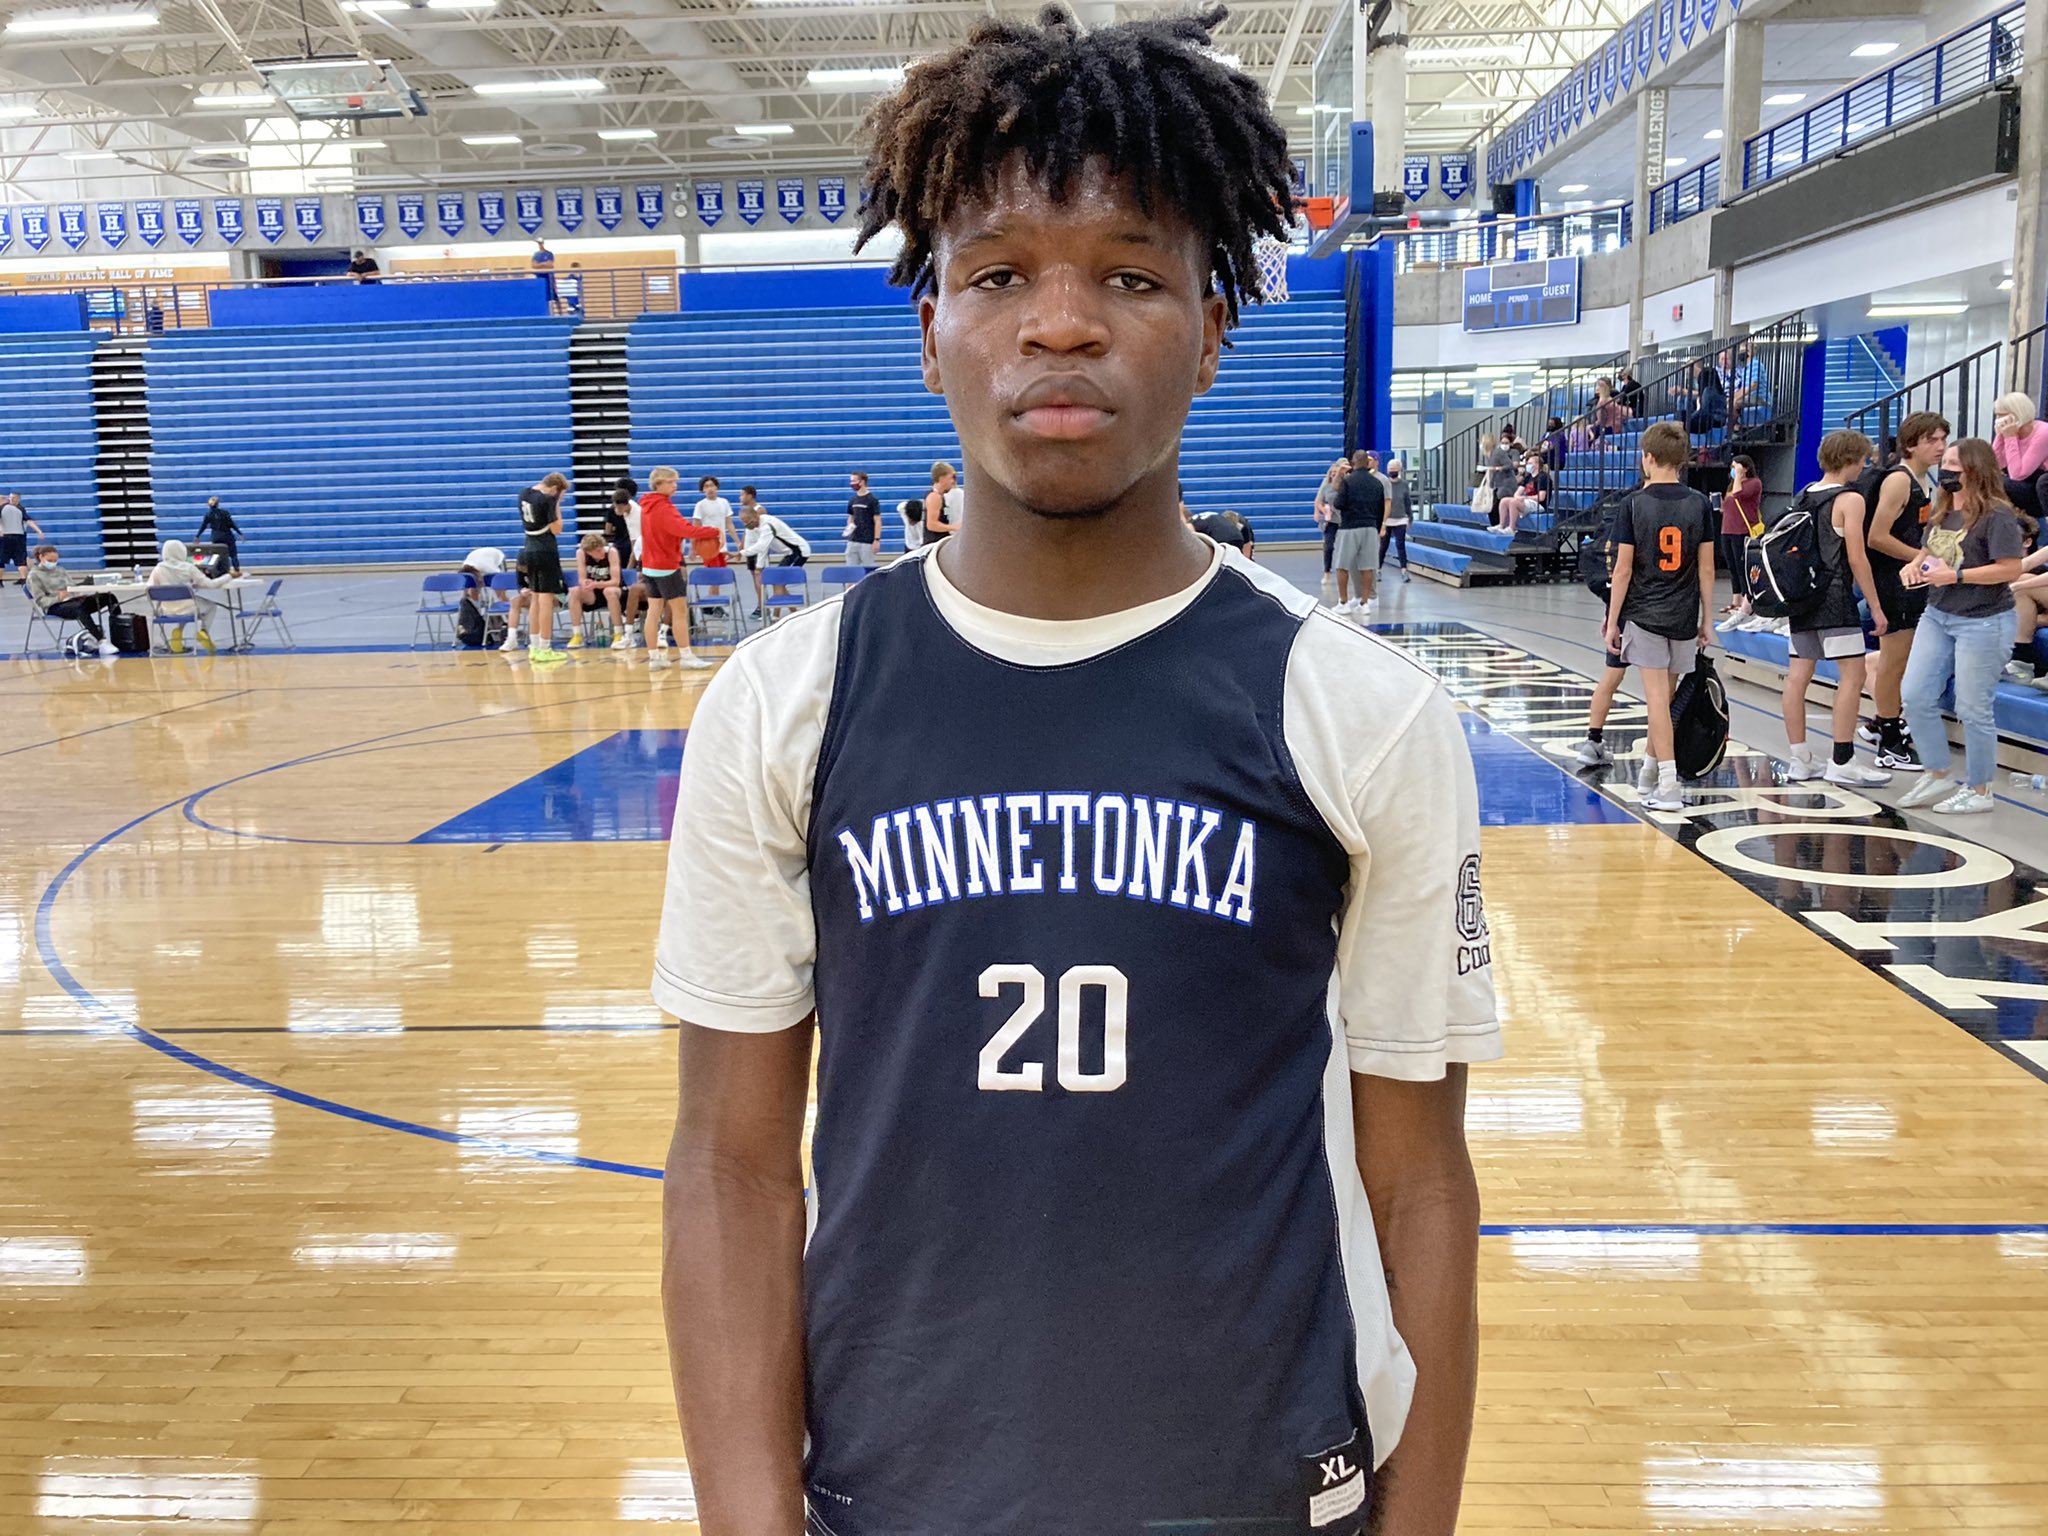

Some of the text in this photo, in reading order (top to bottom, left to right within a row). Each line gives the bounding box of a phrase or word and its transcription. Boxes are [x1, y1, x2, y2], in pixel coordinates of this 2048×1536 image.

[1646, 89, 1666, 186] CHALLENGE
[1408, 168, 1423, 184] H
[1447, 167, 1462, 182] H
[642, 197, 658, 212] H
[702, 194, 717, 210] H
[743, 193, 759, 208] H
[783, 191, 799, 207] H
[824, 190, 839, 205] H
[403, 206, 419, 221] H
[443, 205, 459, 220] H
[483, 203, 499, 219] H
[522, 202, 537, 217] H
[562, 200, 577, 215] H
[601, 198, 617, 214] H
[104, 215, 120, 230] H
[143, 214, 158, 229] H
[181, 212, 197, 228] H
[221, 211, 237, 227] H
[262, 210, 278, 225] H
[301, 209, 316, 225] H
[363, 208, 379, 223] H
[27, 218, 43, 233] H
[65, 216, 80, 231] H
[25, 269, 174, 282] HOPKINS ATHLETIC HALL OF FAME
[1543, 284, 1571, 297] GUEST
[1469, 292, 1493, 305] HOME
[1508, 294, 1529, 303] PERIOD
[1659, 526, 1682, 571] 9
[834, 792, 1257, 926] MINNETONKA
[977, 962, 1128, 1092] 20
[1319, 1455, 1357, 1486] XL
